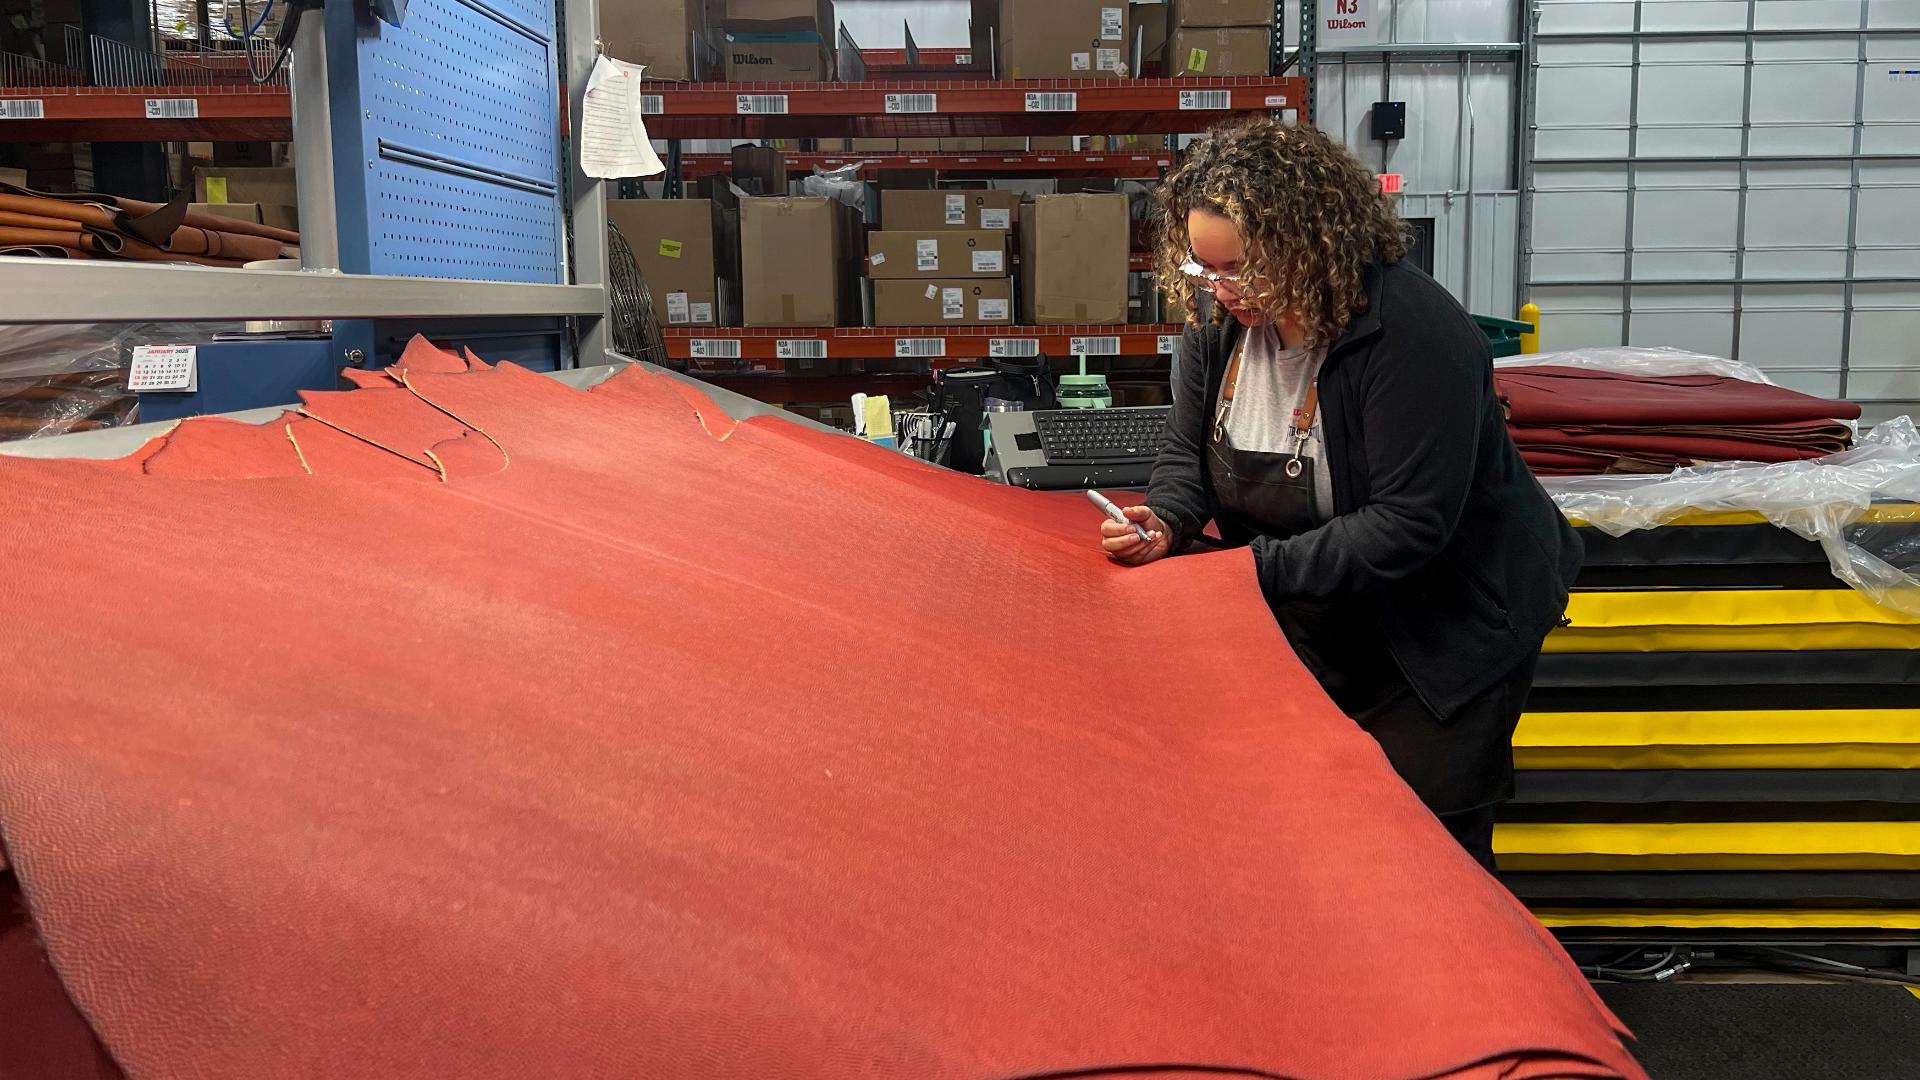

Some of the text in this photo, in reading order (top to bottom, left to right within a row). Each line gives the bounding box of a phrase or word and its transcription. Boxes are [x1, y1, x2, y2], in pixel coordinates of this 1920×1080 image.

[1336, 0, 1358, 14] N3
[1327, 18, 1366, 29] Wilson
[732, 54, 772, 64] Wilson
